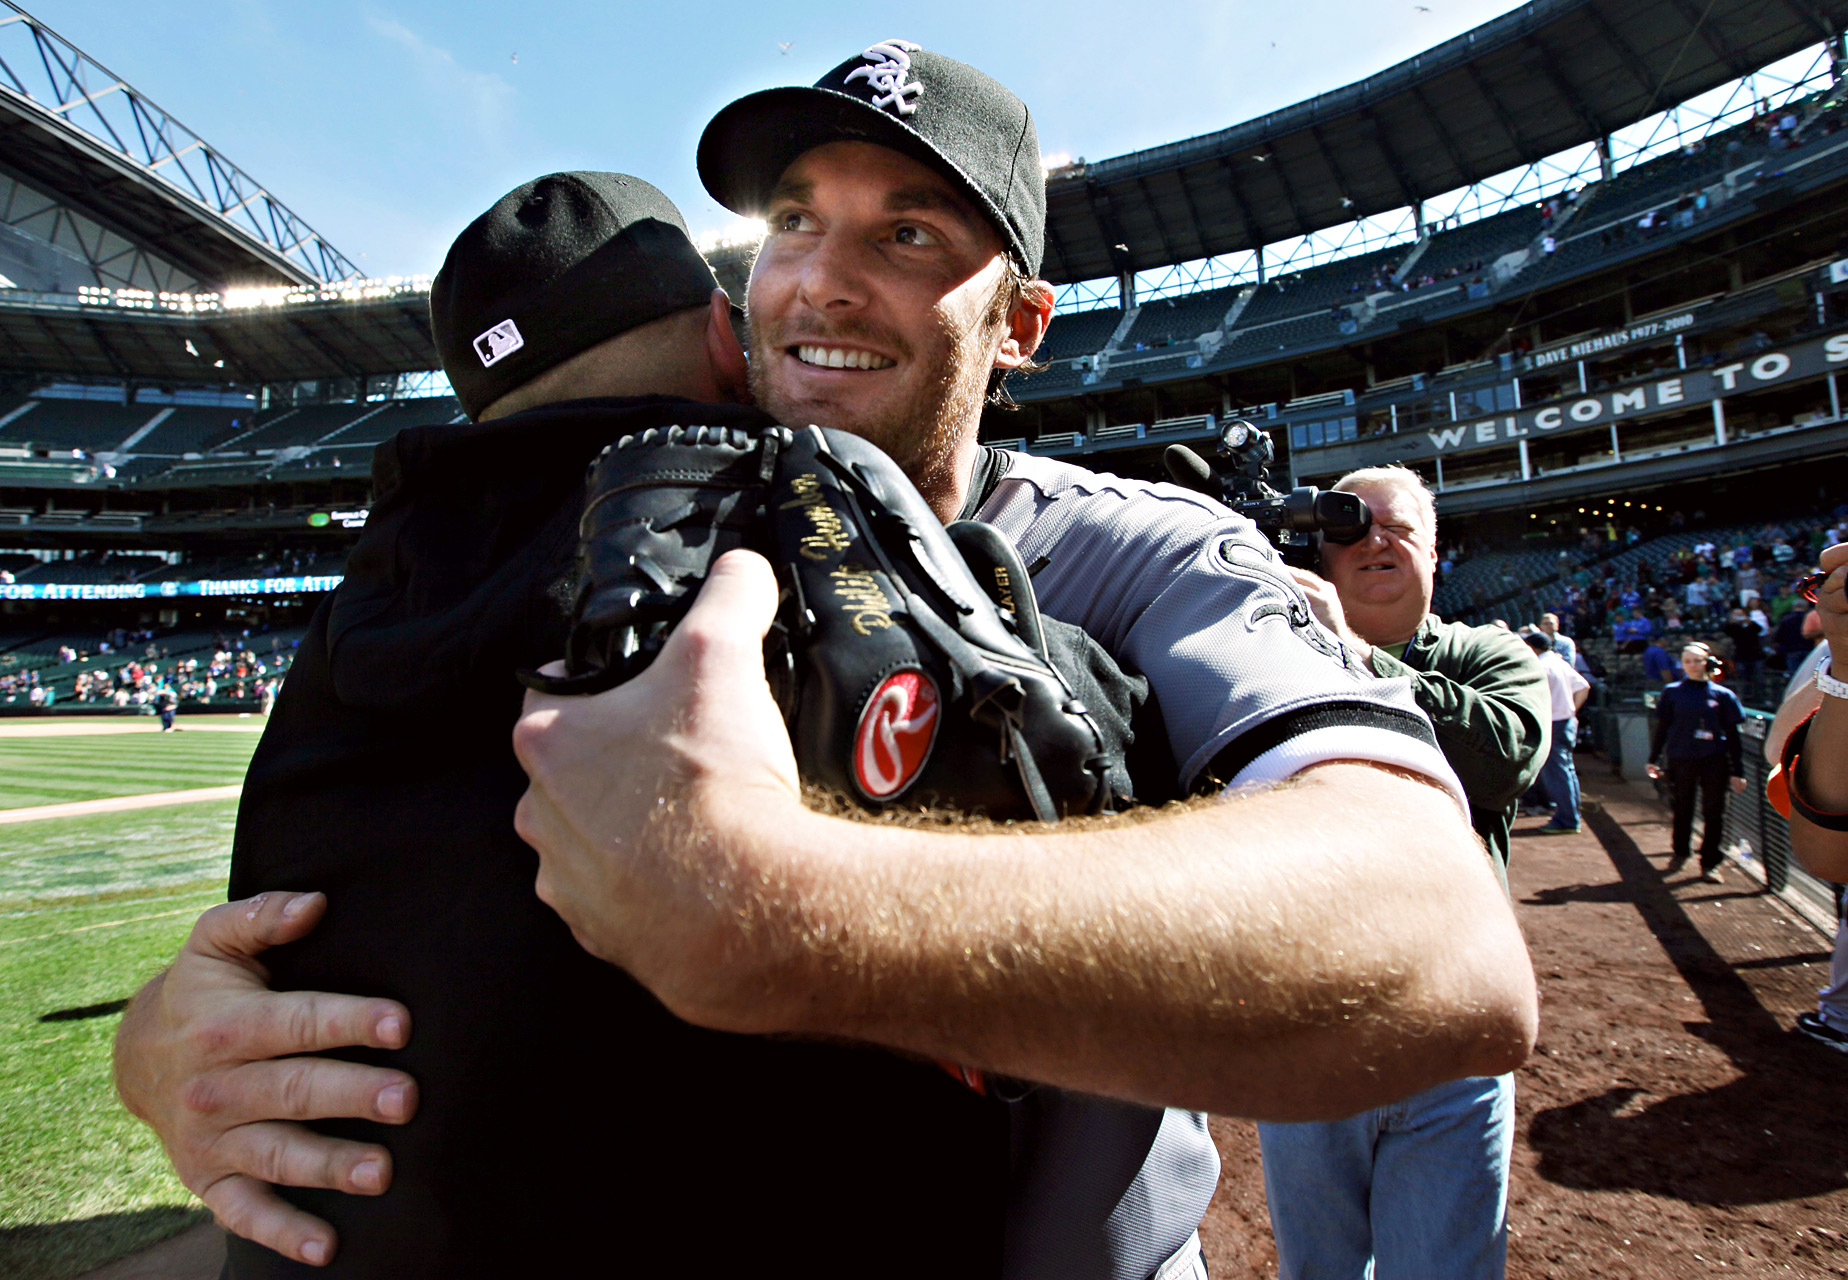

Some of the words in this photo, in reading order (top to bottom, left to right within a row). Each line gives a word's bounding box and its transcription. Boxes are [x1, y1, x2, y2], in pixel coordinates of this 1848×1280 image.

[1535, 347, 1570, 368] DAVE
[1570, 330, 1629, 358] NIEHAUS
[1427, 378, 1684, 450] WELCOME
[1712, 353, 1790, 390] TO
[42, 583, 146, 599] ATTENDING
[200, 580, 259, 596] THANKS
[265, 578, 297, 593] FOR
[994, 566, 1018, 624] LAYER
